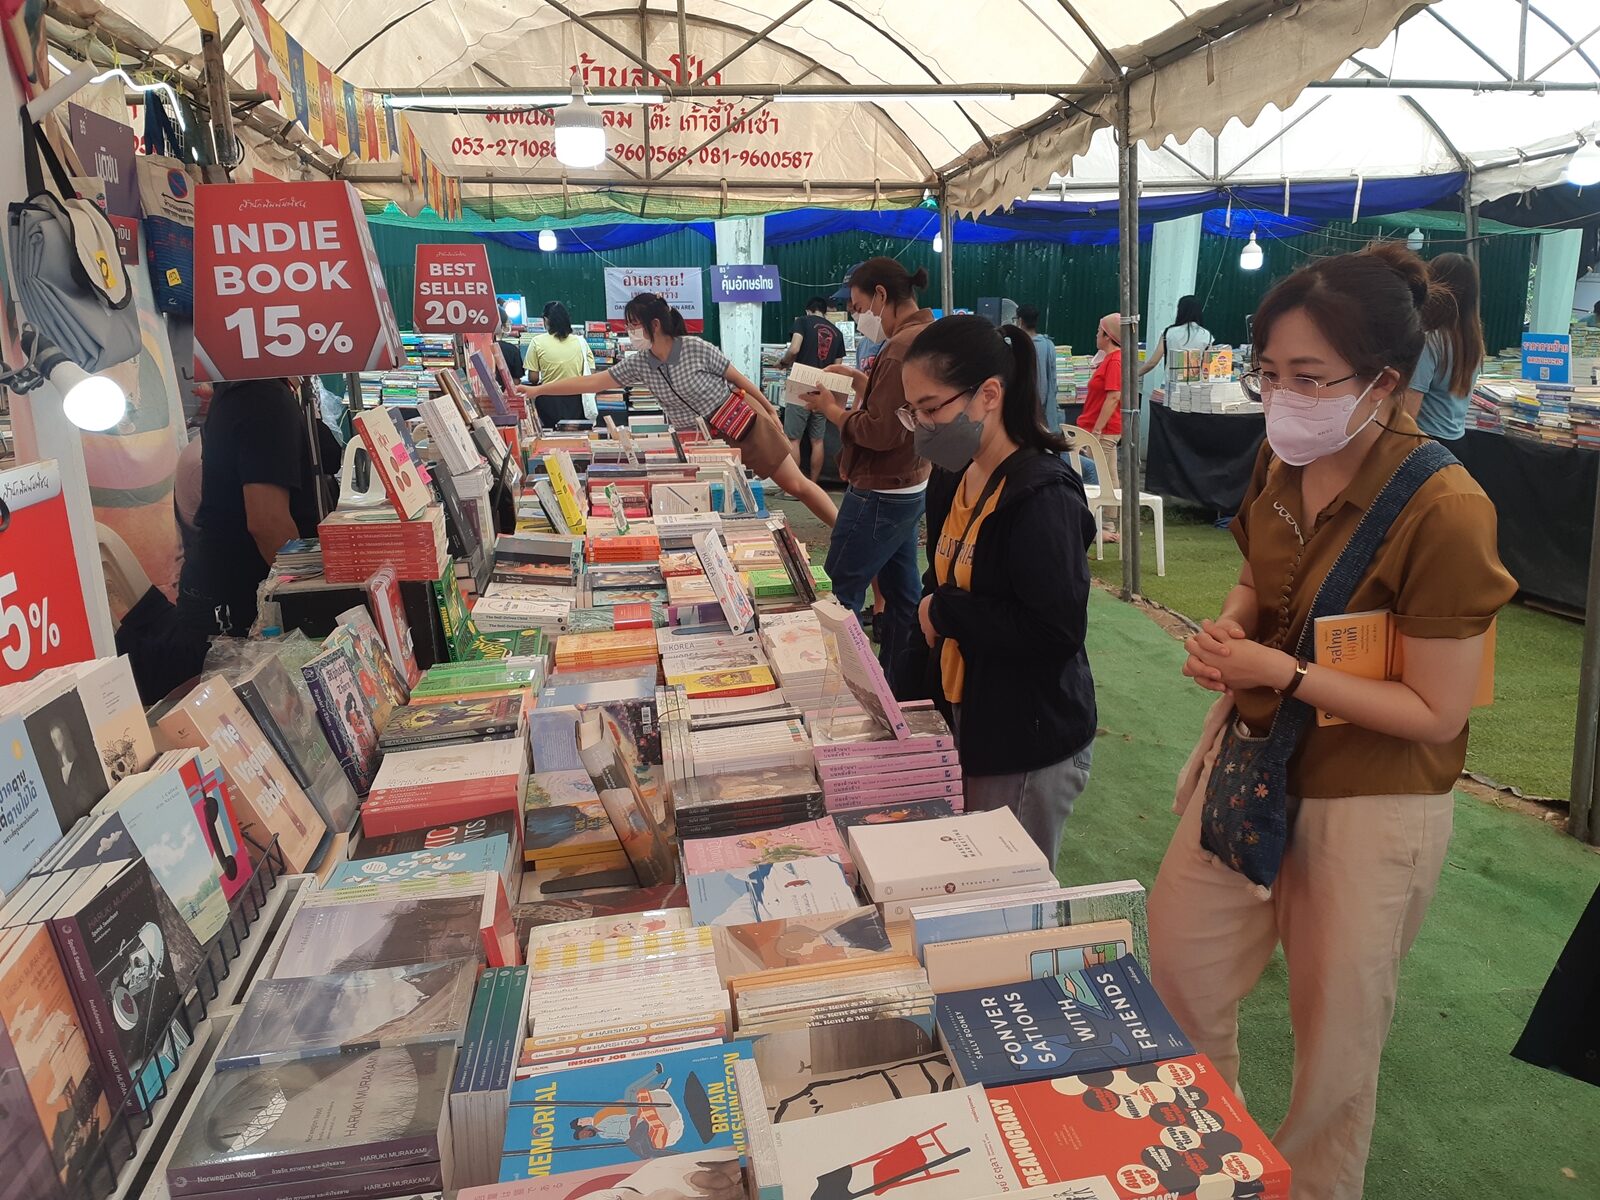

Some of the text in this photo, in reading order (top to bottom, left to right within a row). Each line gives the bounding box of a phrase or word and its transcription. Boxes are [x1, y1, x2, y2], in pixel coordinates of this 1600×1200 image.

[699, 147, 814, 169] 081-9600587
[212, 219, 341, 255] INDIE
[213, 260, 352, 296] BOOK
[429, 263, 476, 277] BEST
[622, 269, 686, 288] อันตราย!
[419, 281, 489, 296] SELLER
[721, 275, 774, 296] คุ้มอักษรไทย
[424, 300, 489, 325] 20%
[224, 304, 354, 360] 15%
[702, 552, 716, 579] KOREA
[668, 642, 695, 652] KOREA
[1326, 628, 1342, 665] รสไทย
[210, 723, 241, 752] The
[823, 1018, 845, 1026] Kent
[827, 1011, 849, 1019] Kent
[1057, 999, 1096, 1042] WITH
[1096, 972, 1158, 1050] FRIENDS
[955, 1011, 984, 1060] SALLY ROONEY
[980, 996, 1029, 1066] CONVER
[1003, 991, 1057, 1064] SATIONS
[567, 1056, 606, 1067] INSIGHT
[608, 1053, 627, 1063] JOB
[106, 1048, 133, 1108] HARUKI MURAKMI
[1168, 1064, 1187, 1086] Educa
[344, 1054, 379, 1138] HARUKI MURAKAMI
[711, 1082, 732, 1134] BRYAN
[1119, 1094, 1142, 1119] Military
[1166, 1127, 1187, 1151] Corrup
[1178, 1130, 1193, 1145] tion
[360, 1147, 428, 1163] HARUKI MURAKAMI
[197, 1169, 257, 1184] Norwegian Wood
[1120, 1169, 1141, 1189] Bud
[1134, 1168, 1157, 1186] get
[1230, 1155, 1251, 1180] Society
[363, 1176, 432, 1191] HARUKI MURAKAMI
